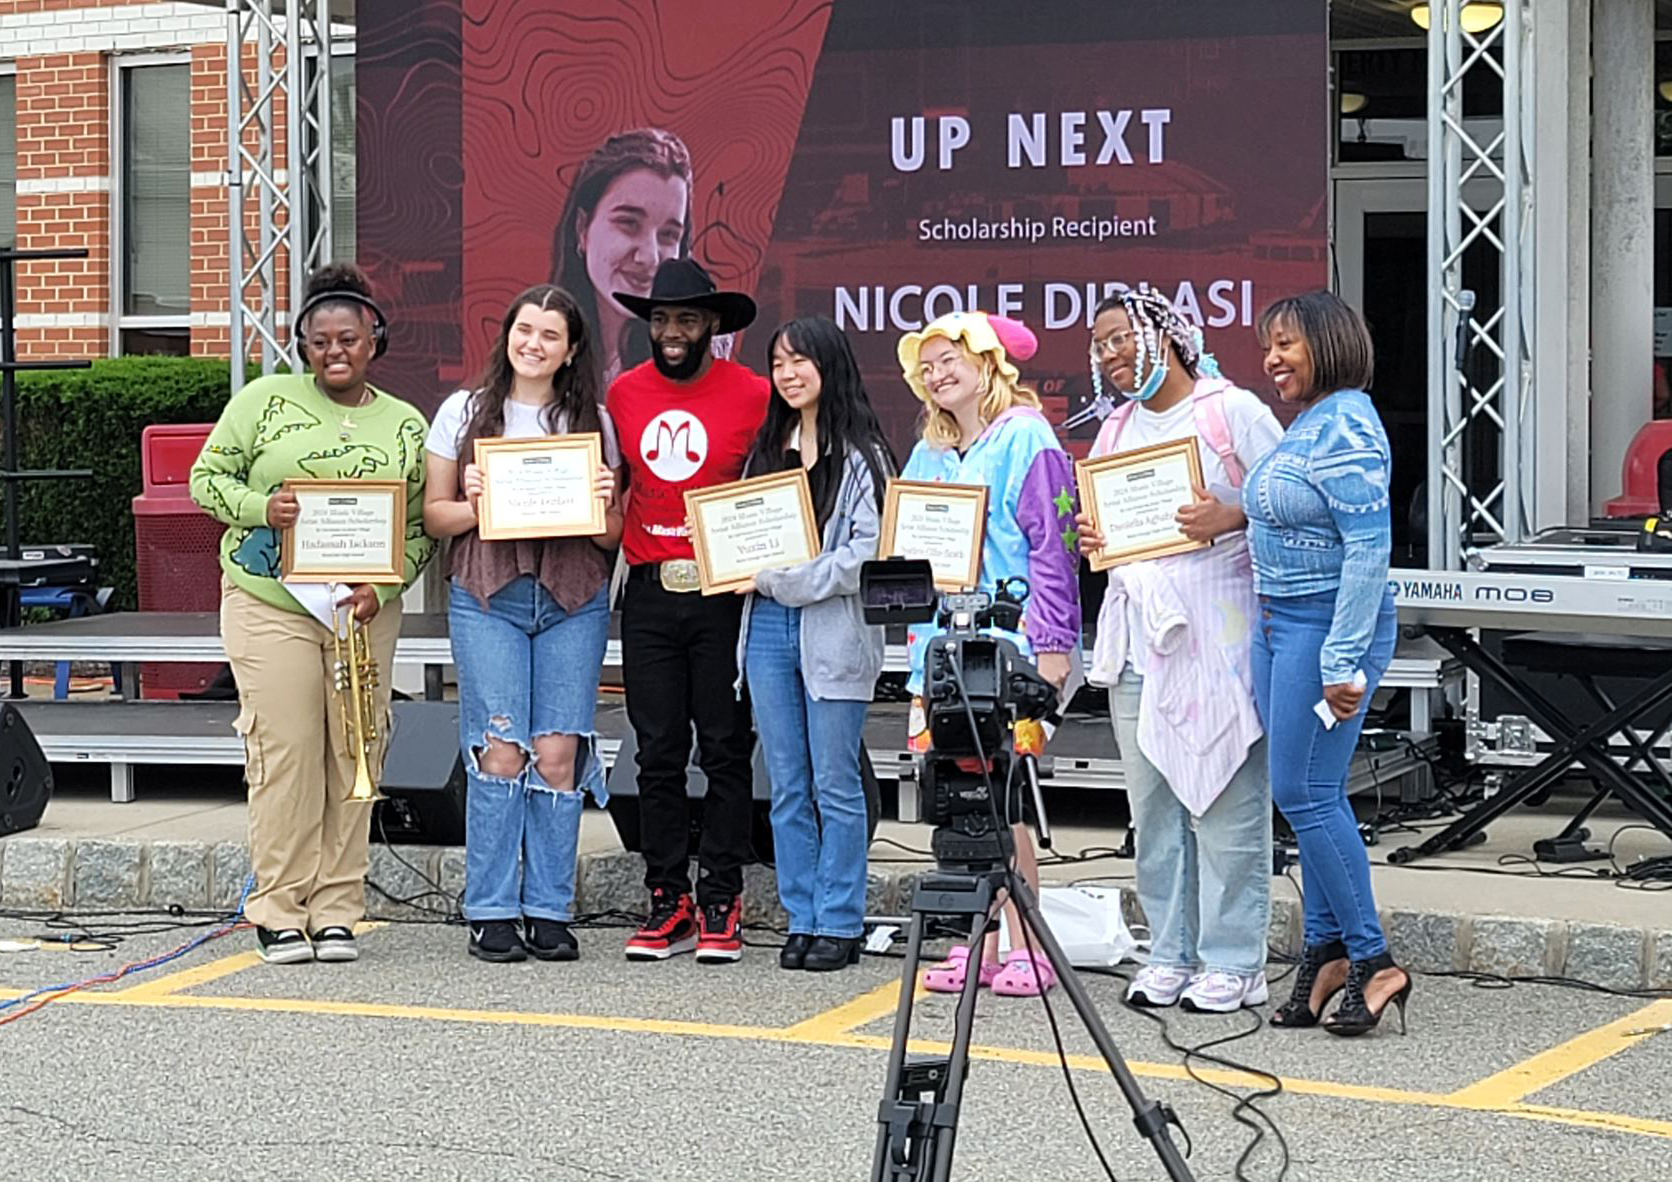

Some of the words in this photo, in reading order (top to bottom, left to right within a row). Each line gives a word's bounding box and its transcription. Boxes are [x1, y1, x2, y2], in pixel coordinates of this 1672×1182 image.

[891, 116, 971, 172] UP
[1008, 109, 1172, 168] NEXT
[919, 217, 1045, 242] Scholarship
[1052, 215, 1157, 241] Recipient
[1044, 280, 1252, 330] DIASI
[1403, 582, 1462, 601] YAMAHA
